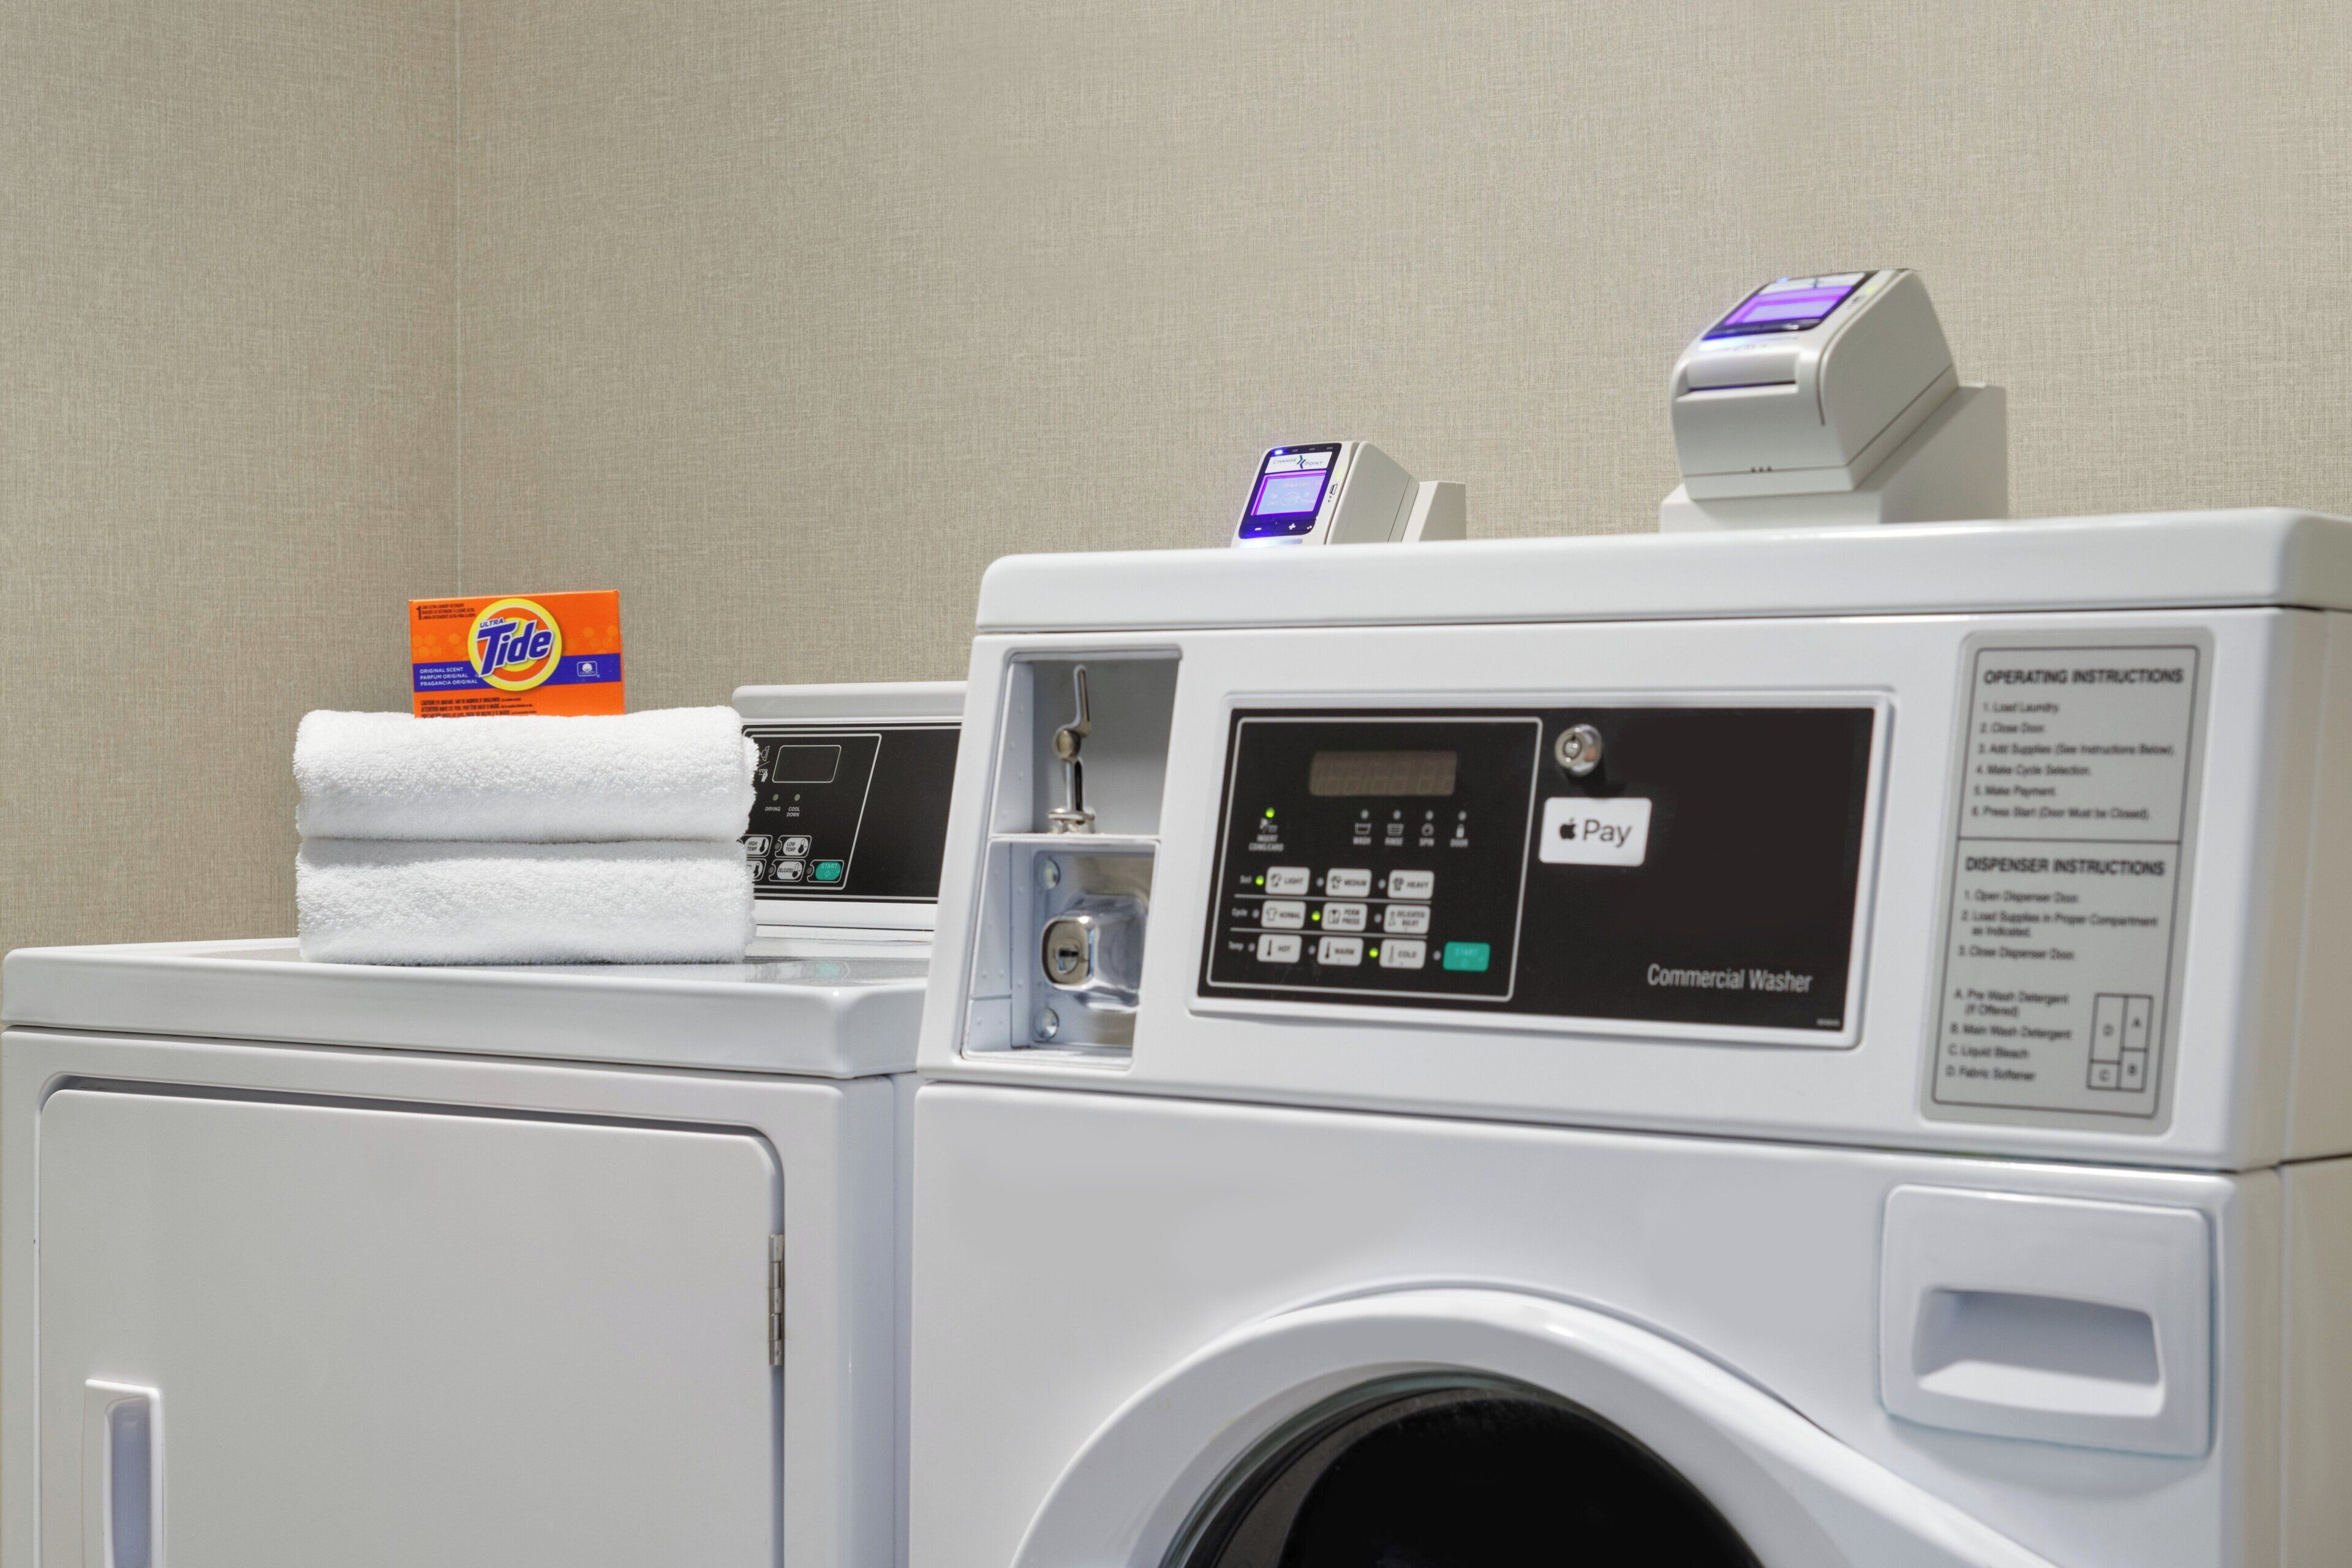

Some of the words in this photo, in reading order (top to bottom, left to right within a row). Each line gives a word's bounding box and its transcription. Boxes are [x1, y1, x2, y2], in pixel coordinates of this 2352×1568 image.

[480, 618, 504, 628] ULTRA
[477, 619, 553, 676] Tide
[1983, 669, 2068, 684] OPERATING
[2072, 668, 2184, 684] INSTRUCTIONS
[1992, 703, 2017, 713] Load
[1992, 722, 2018, 733] Close
[1989, 744, 2008, 754] Add
[2011, 743, 2051, 755] Supplies
[2081, 744, 2135, 755] Instructions
[1987, 764, 2011, 775] Make
[2015, 764, 2041, 777] Cycle
[1985, 785, 2010, 796] Make
[1983, 805, 2010, 816] Press
[2013, 805, 2036, 817] Start
[2068, 807, 2090, 818] Must
[1583, 819, 1632, 848] Pay
[1352, 836, 1371, 845] WASH
[1384, 837, 1403, 846] RINSE
[1419, 837, 1434, 847] SPIN
[1965, 857, 2049, 873] DISPENSER
[2053, 859, 2166, 876] INSTRUCTIONS
[1974, 889, 1999, 902] Open
[2003, 889, 2050, 903] Dispenser
[1972, 911, 1997, 922] Load
[2000, 910, 2040, 924] Supplies
[2054, 911, 2086, 926] Proper
[1969, 945, 1996, 957] Close
[1999, 946, 2046, 959] Dispenser
[1647, 963, 1745, 990] Commercial
[1749, 968, 1813, 993] Washer
[1967, 989, 1984, 1000] Pre
[1988, 990, 2014, 1001] Wash
[2019, 991, 2070, 1006] Detergent
[2103, 1023, 2114, 1037] D
[2132, 1017, 2142, 1029] A
[1962, 1023, 1986, 1035] Main
[1991, 1025, 2017, 1036] Wash
[2022, 1025, 2073, 1042] Detergent
[1961, 1044, 1991, 1058] Liquid
[1994, 1046, 2030, 1059] Bleach
[1959, 1066, 1988, 1079] Fabric
[1993, 1067, 2036, 1081] Softener
[2098, 1068, 2110, 1082] C
[2127, 1063, 2138, 1077] B
